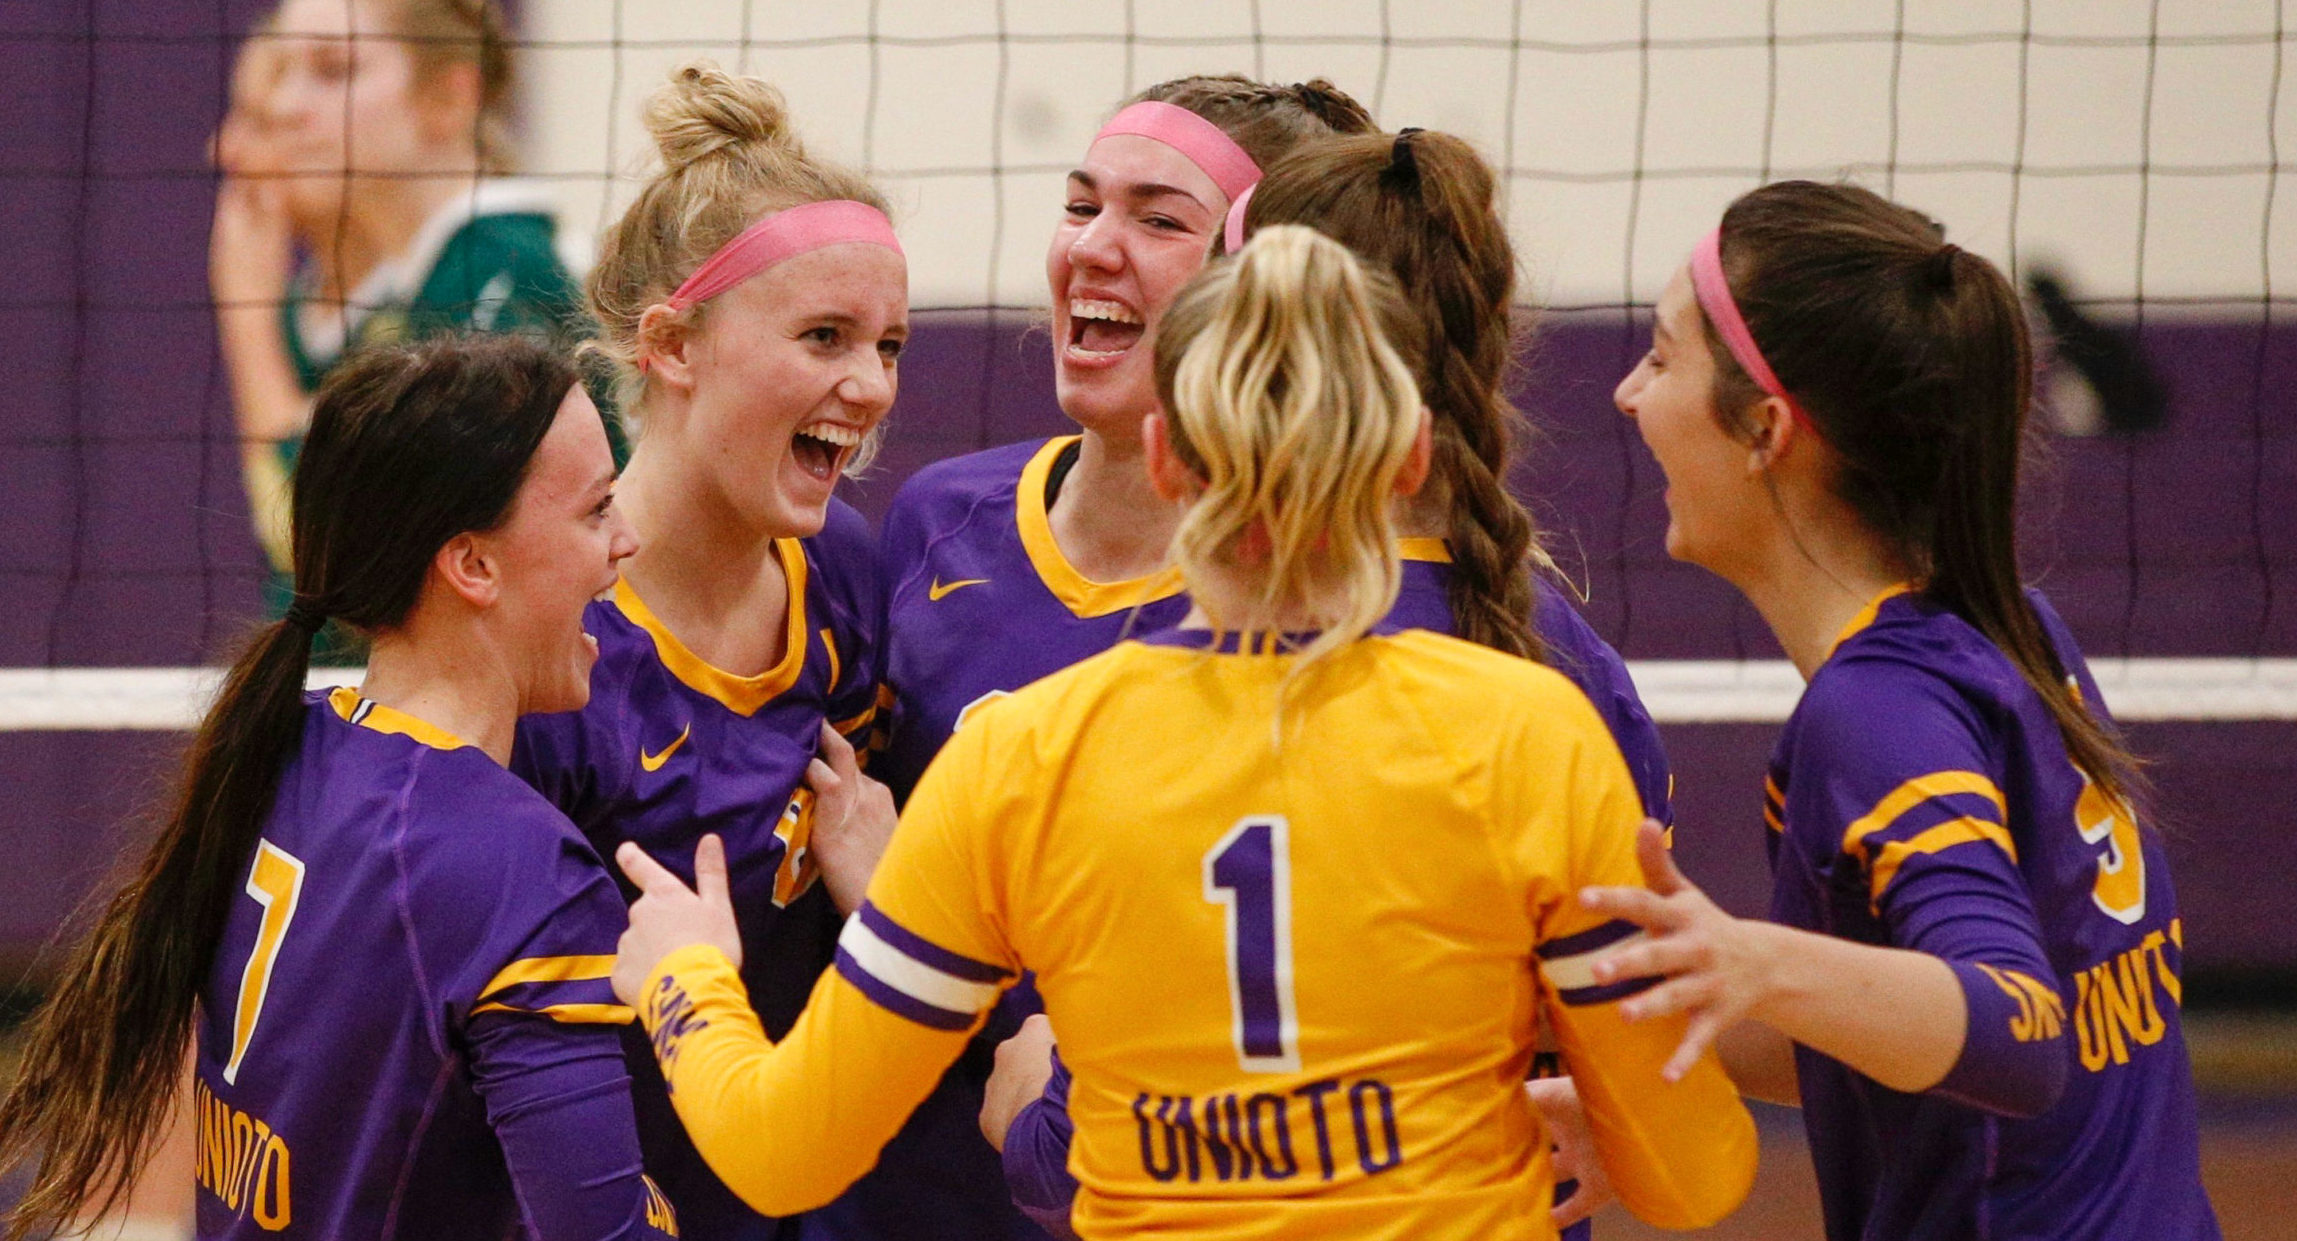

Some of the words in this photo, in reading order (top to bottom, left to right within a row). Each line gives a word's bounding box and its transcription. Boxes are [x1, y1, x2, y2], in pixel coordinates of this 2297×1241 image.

[222, 838, 305, 1086] 7
[1202, 814, 1301, 1073] 1
[195, 1078, 292, 1232] UNIOTO
[1132, 1079, 1402, 1182] UNIOTO
